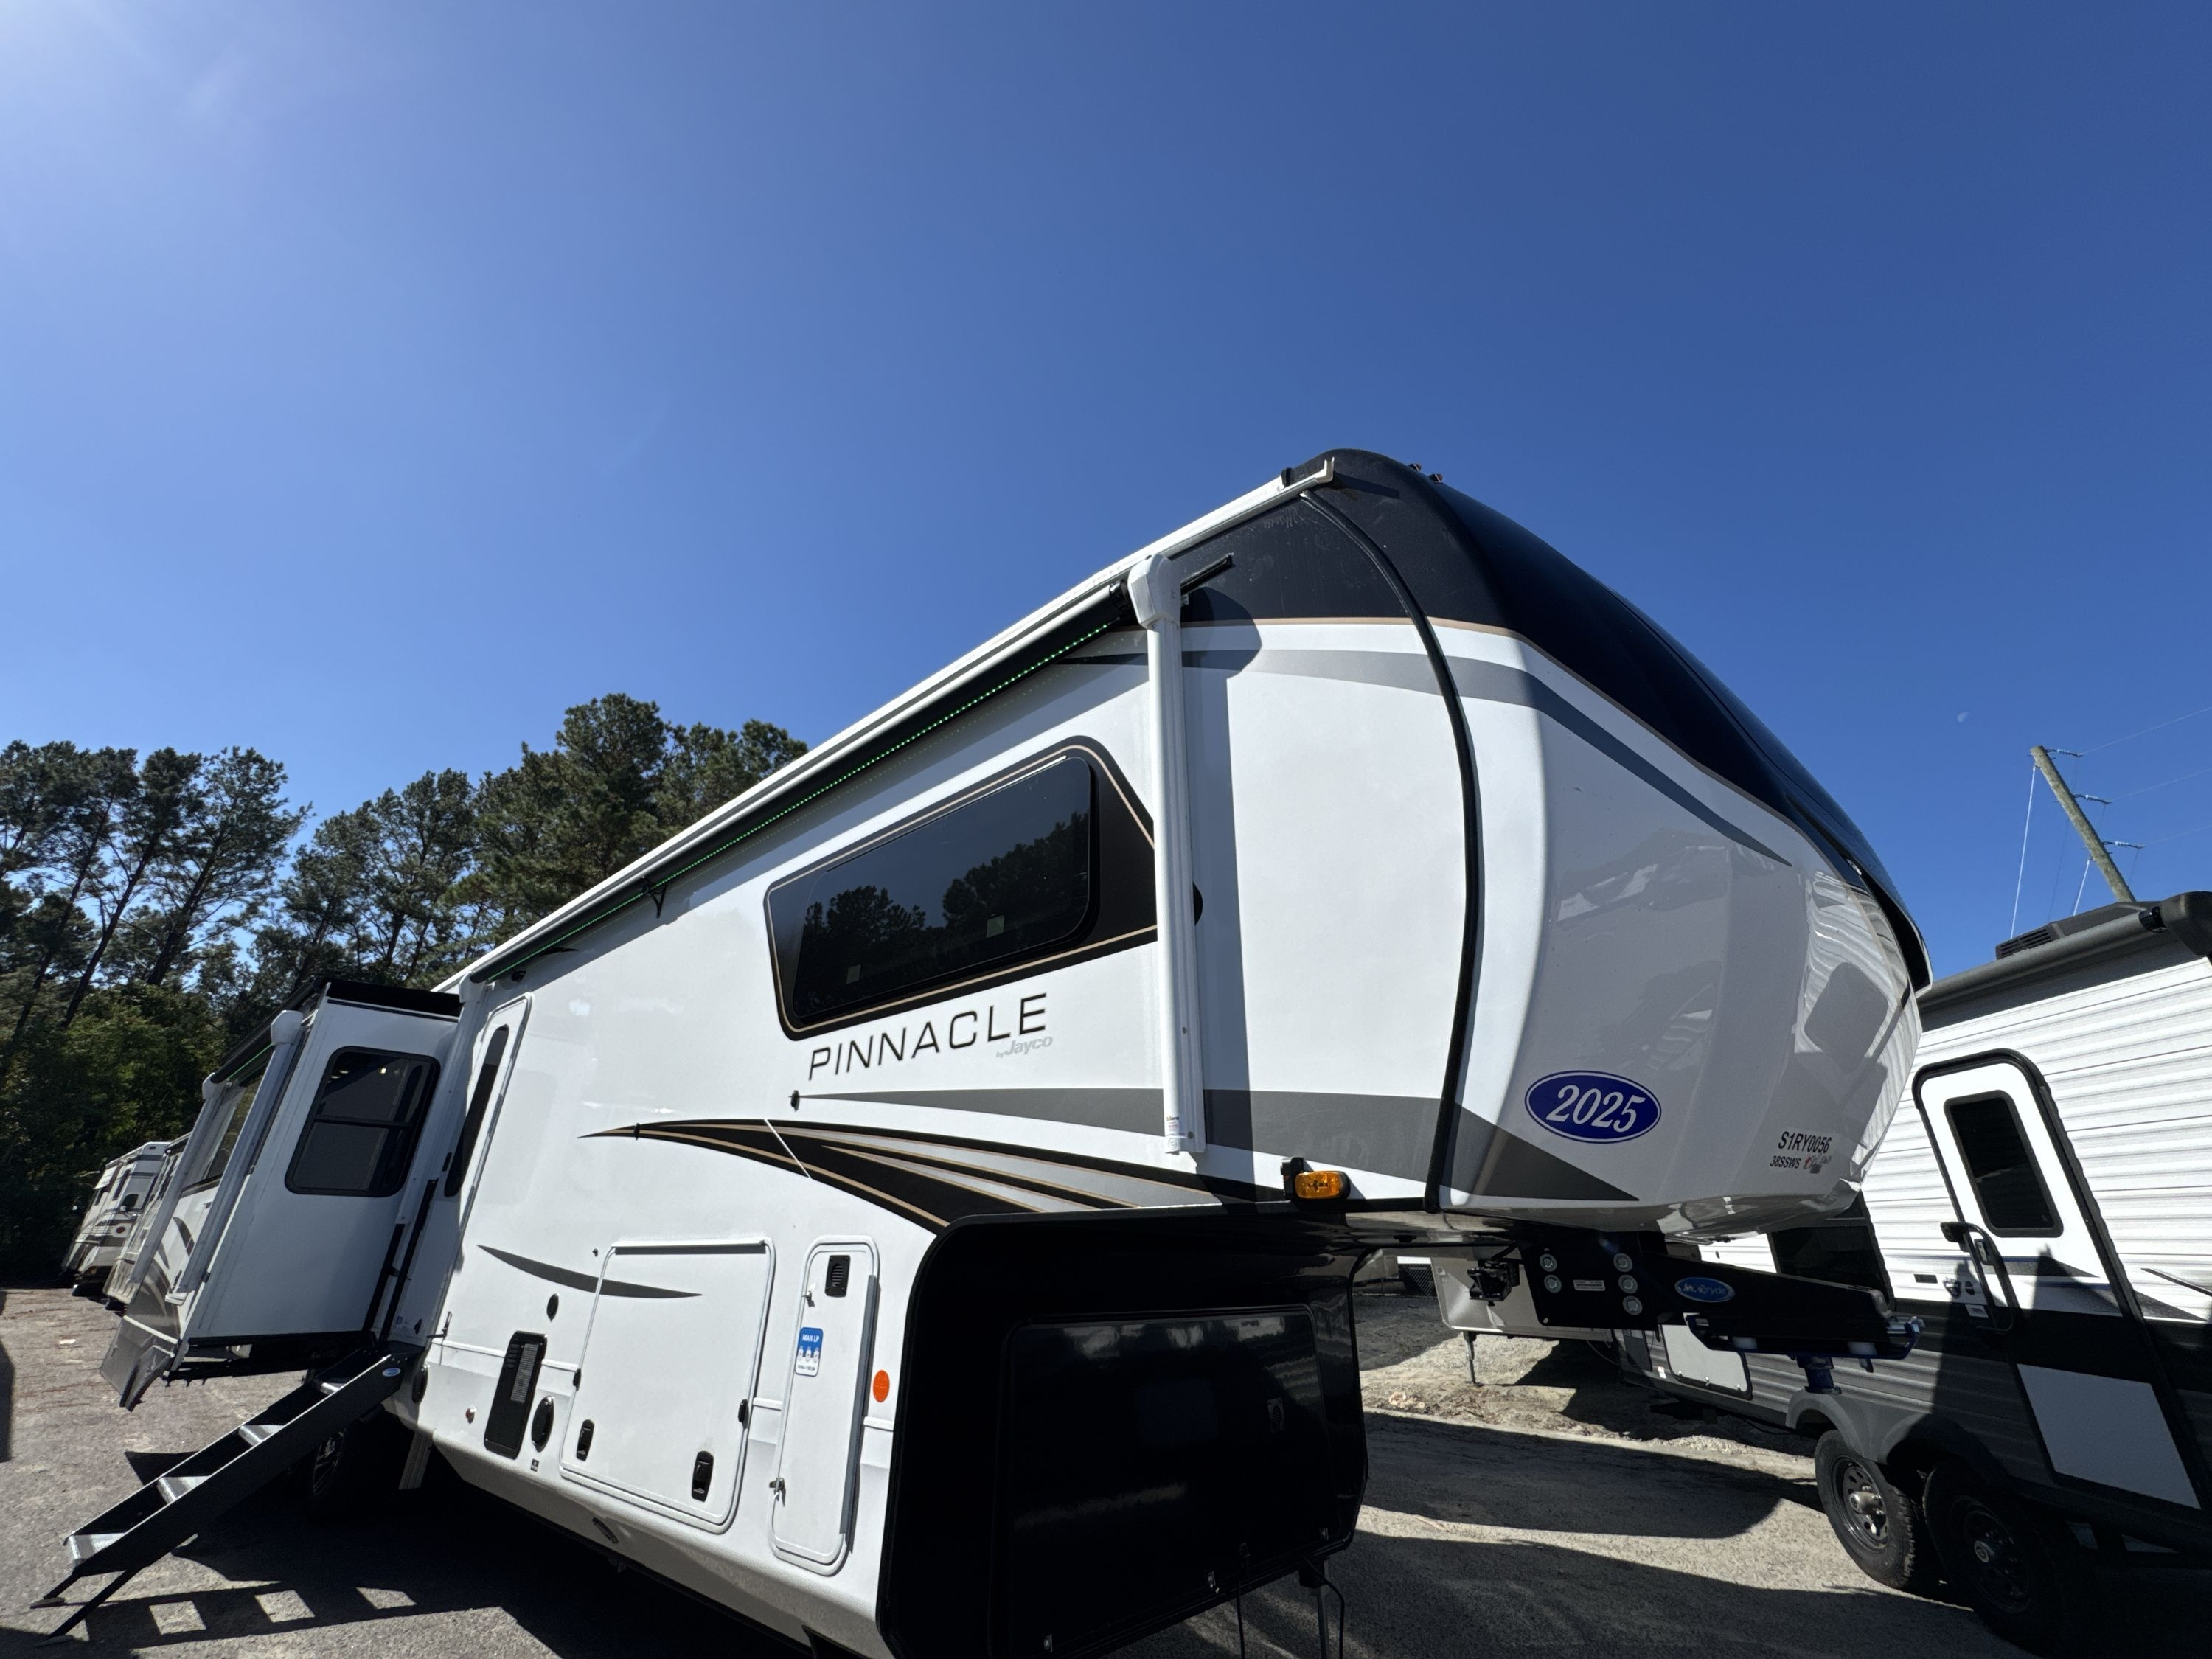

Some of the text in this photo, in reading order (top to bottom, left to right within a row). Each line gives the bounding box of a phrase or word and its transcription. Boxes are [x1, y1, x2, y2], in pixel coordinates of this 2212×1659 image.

[808, 992, 1047, 1081] PINNACLE
[1004, 1036, 1054, 1056] Jayco
[1545, 1085, 1646, 1133] 2025
[1778, 1131, 1832, 1154] S1RY0056
[1770, 1155, 1802, 1169] 38SSWS
[802, 1334, 814, 1342] MAX
